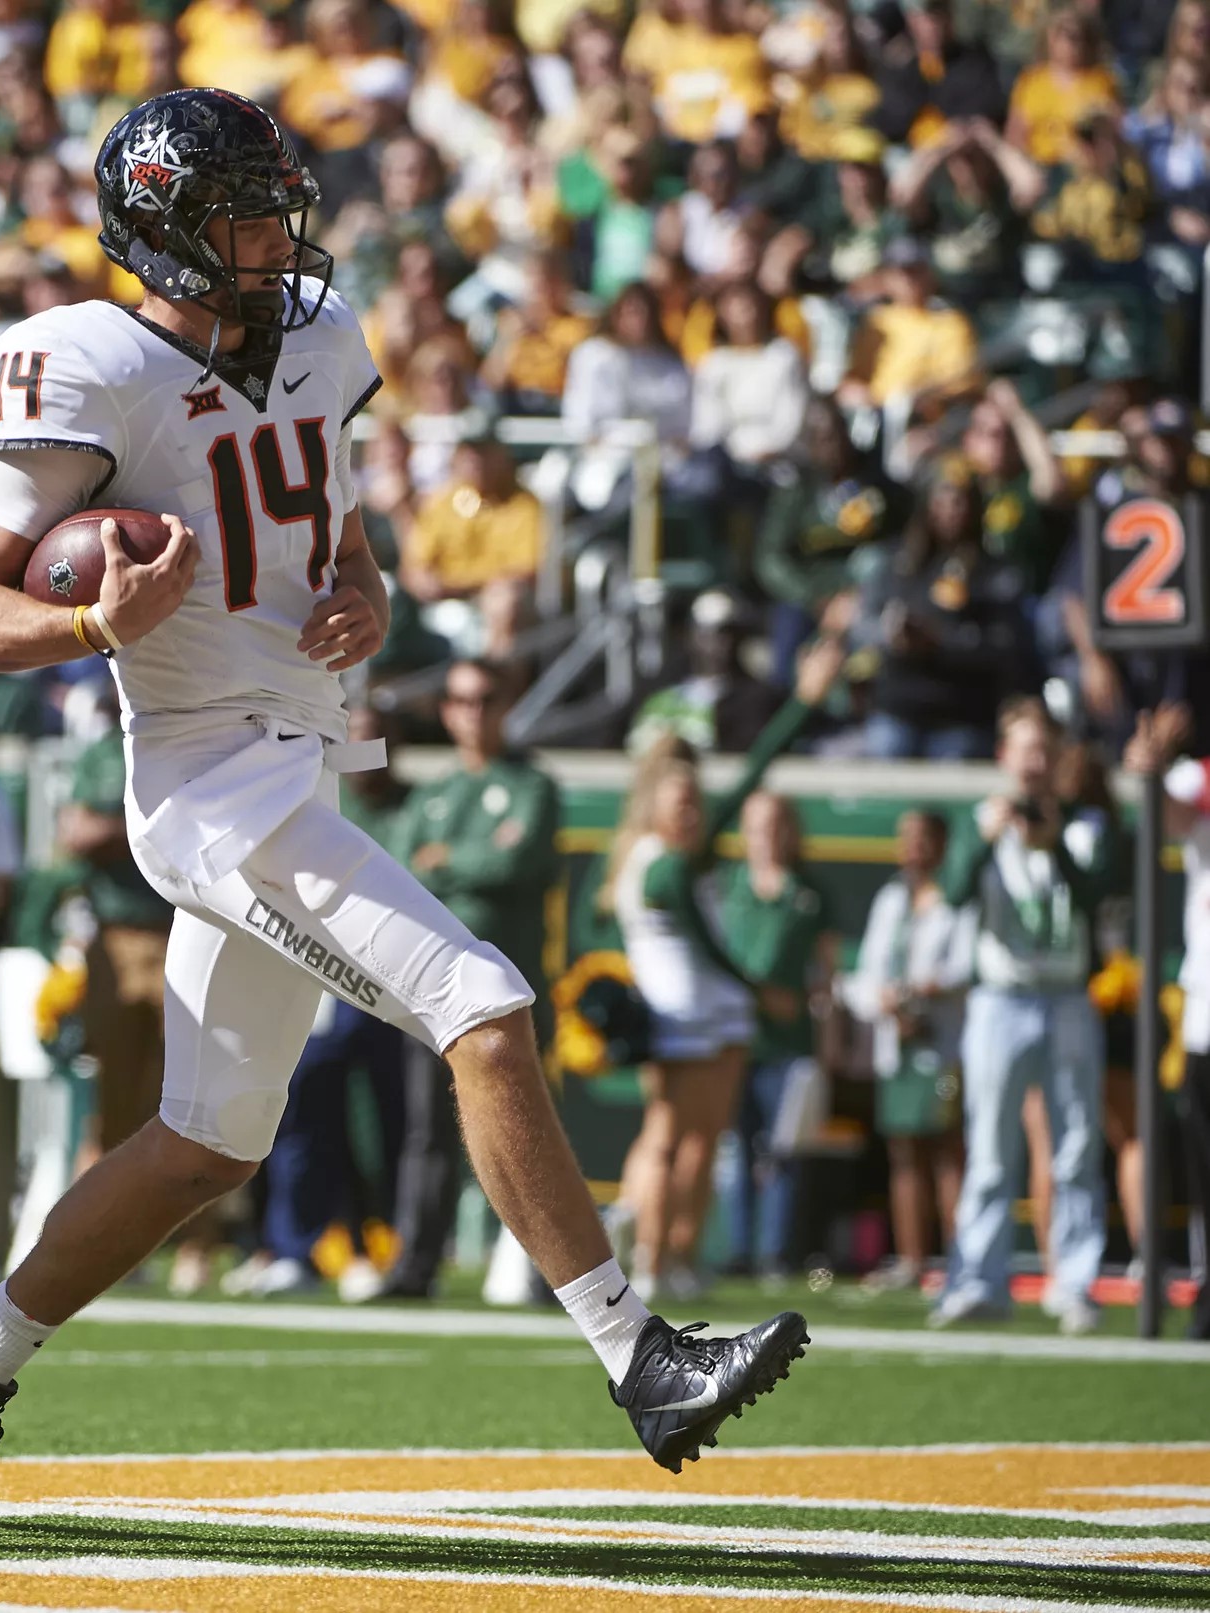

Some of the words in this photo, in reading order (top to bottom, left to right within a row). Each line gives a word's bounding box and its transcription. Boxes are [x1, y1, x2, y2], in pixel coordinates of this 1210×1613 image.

[199, 238, 225, 268] COWBOY
[181, 384, 228, 421] XII
[207, 415, 331, 613] 14
[1102, 500, 1186, 625] 2
[244, 896, 384, 1008] COWBOYS
